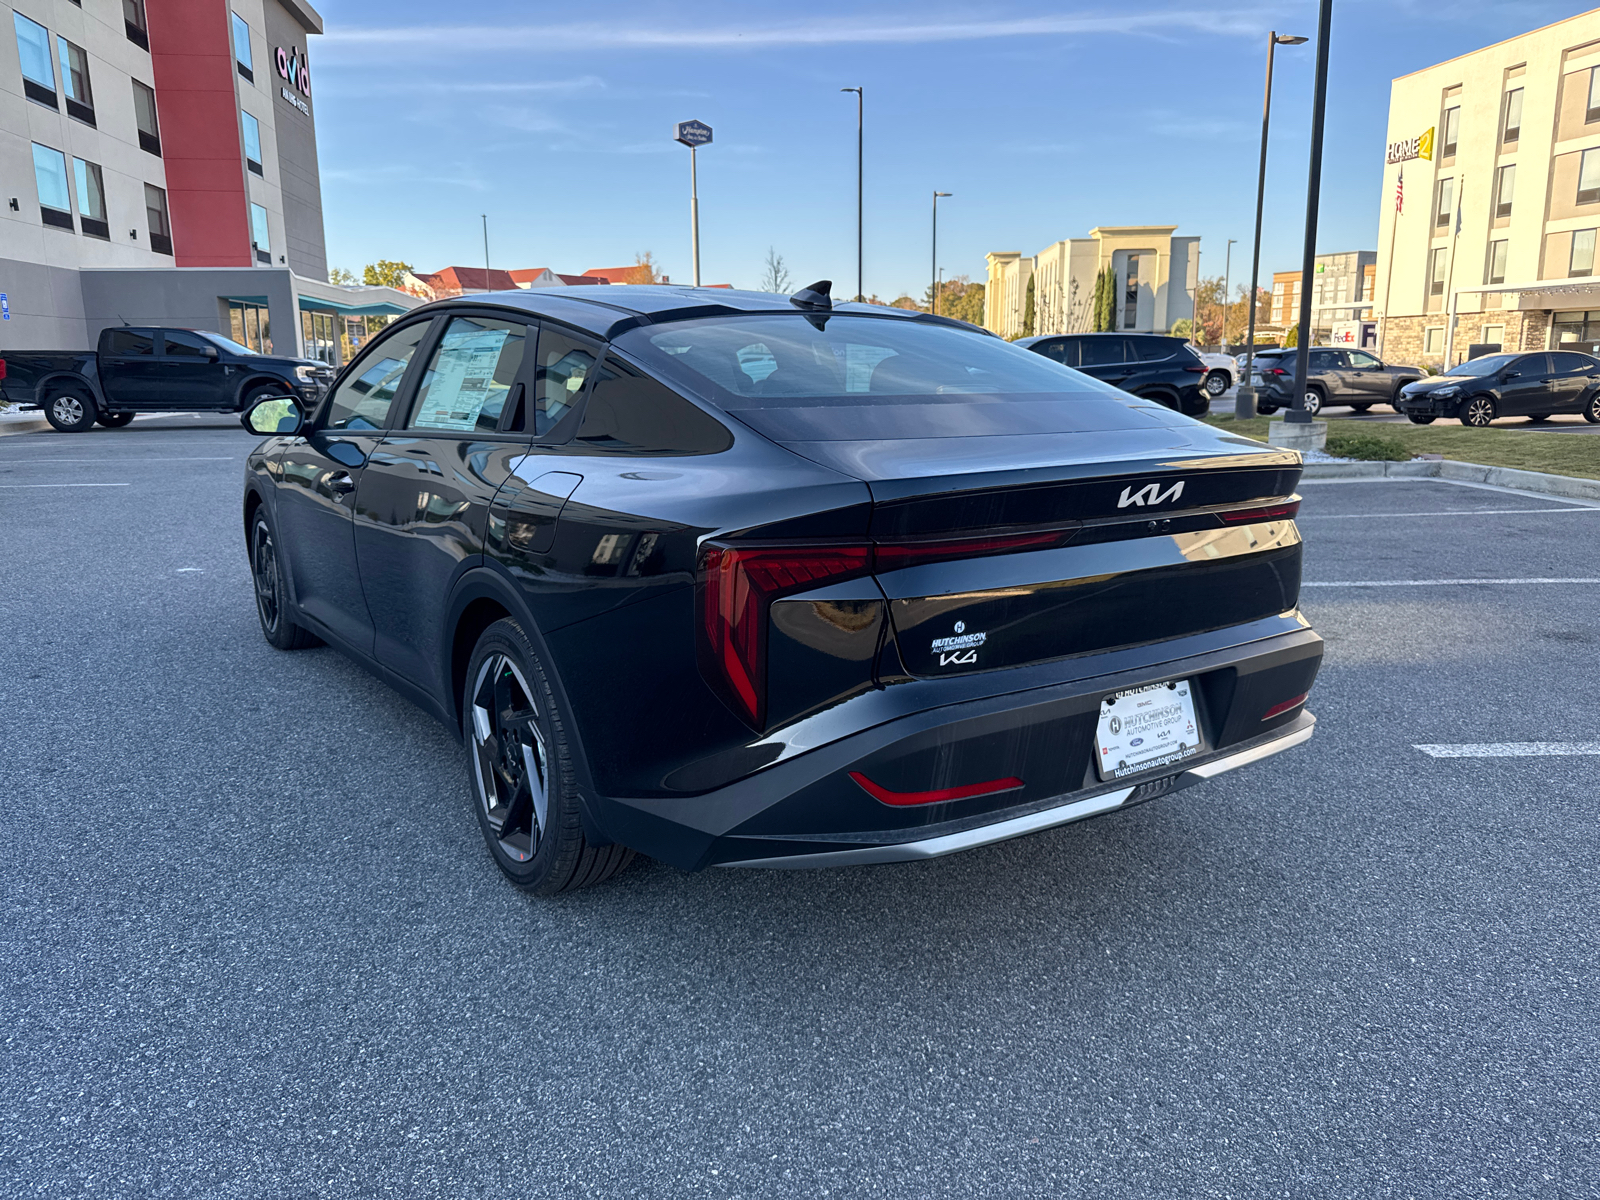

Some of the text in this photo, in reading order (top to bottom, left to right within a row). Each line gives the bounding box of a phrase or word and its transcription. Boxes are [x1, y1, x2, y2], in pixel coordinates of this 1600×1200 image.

[275, 46, 310, 98] avid
[1334, 331, 1355, 343] FedEx
[1117, 481, 1185, 509] KIA
[932, 632, 986, 647] HUTCHINSON
[940, 650, 977, 666] K4
[1137, 700, 1152, 708] GMC
[1123, 702, 1184, 730] HUTCHINSON
[1127, 715, 1181, 736] AUTOMOTIVE GROUP
[1114, 747, 1197, 778] Hutchinsonautogroup.com
